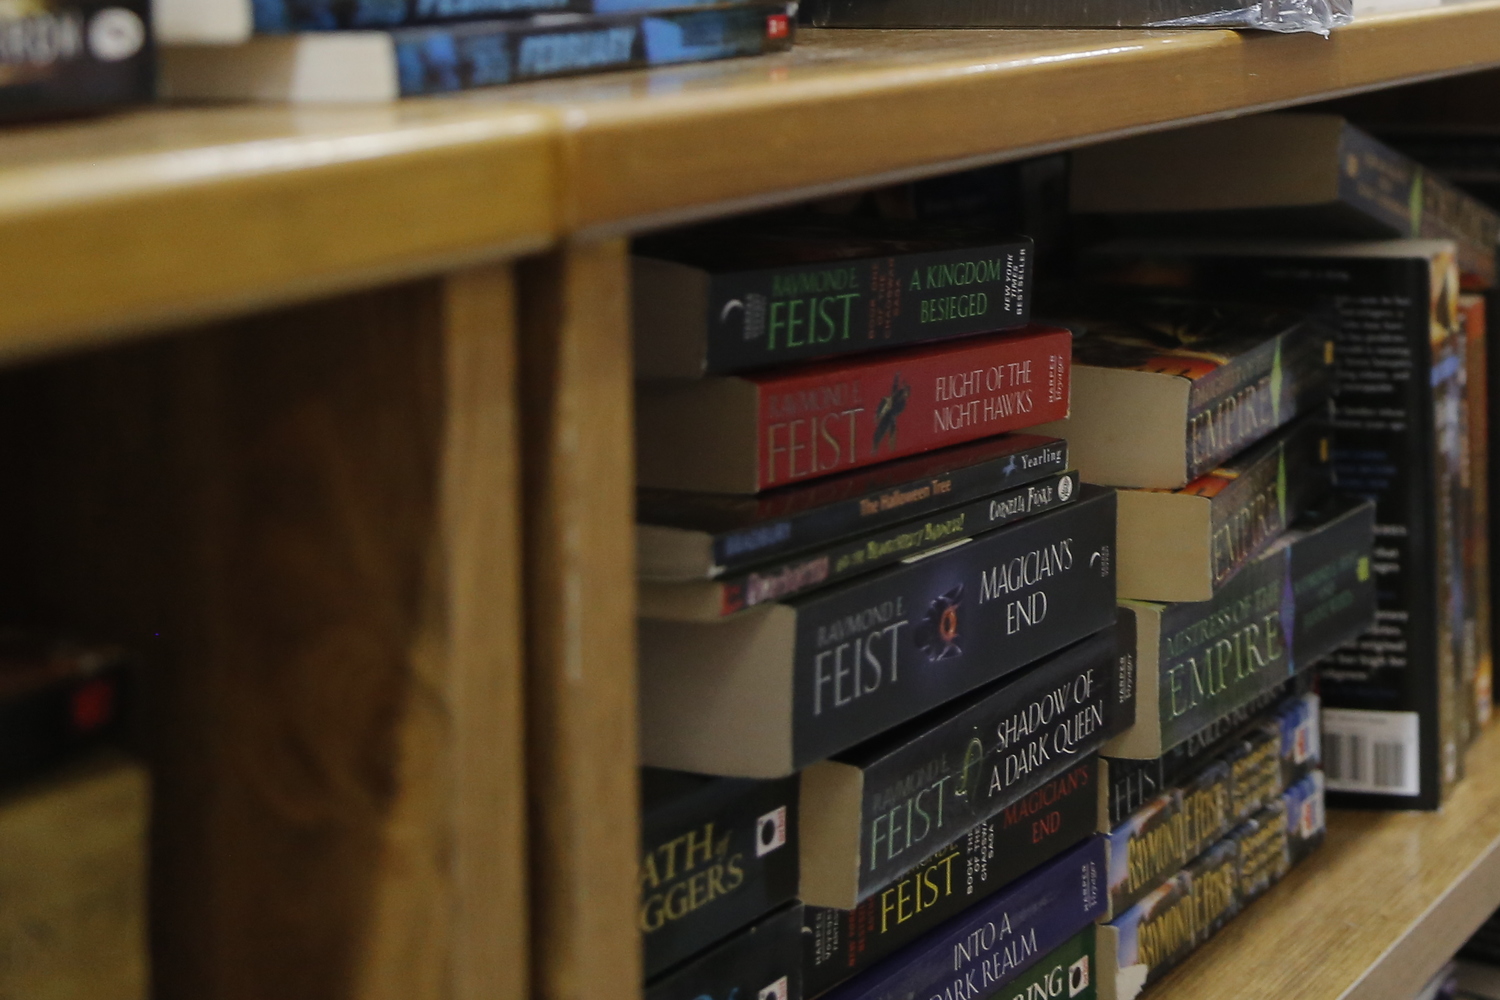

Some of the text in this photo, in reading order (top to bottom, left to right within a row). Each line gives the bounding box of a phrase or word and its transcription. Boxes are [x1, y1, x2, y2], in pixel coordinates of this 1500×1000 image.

[909, 258, 1001, 292] A KINGDOM
[1003, 253, 1014, 312] NEW YORK
[1011, 264, 1019, 298] TIMES
[1016, 248, 1026, 316] BESTSELLER
[767, 293, 861, 350] FEIST
[920, 293, 988, 324] BESIEGED
[935, 360, 1032, 402] FLIGHT OF THE
[1048, 354, 1056, 403] HARPER
[934, 389, 1034, 434] NIGHT HAWKS
[767, 408, 864, 484] FEIST
[1021, 449, 1063, 472] Yearling
[1007, 571, 1048, 635] END
[813, 620, 908, 715] FEIST
[1168, 611, 1281, 717] EMPIRE
[996, 668, 1094, 754] SHADOW OF
[988, 700, 1104, 797] A DARK QUEEN
[869, 775, 951, 871] FEIST
[1031, 811, 1062, 844] END
[880, 852, 960, 934] FEIST
[966, 859, 974, 895] BOOK
[954, 912, 1012, 971] INTO A
[982, 928, 1038, 987] REALM
